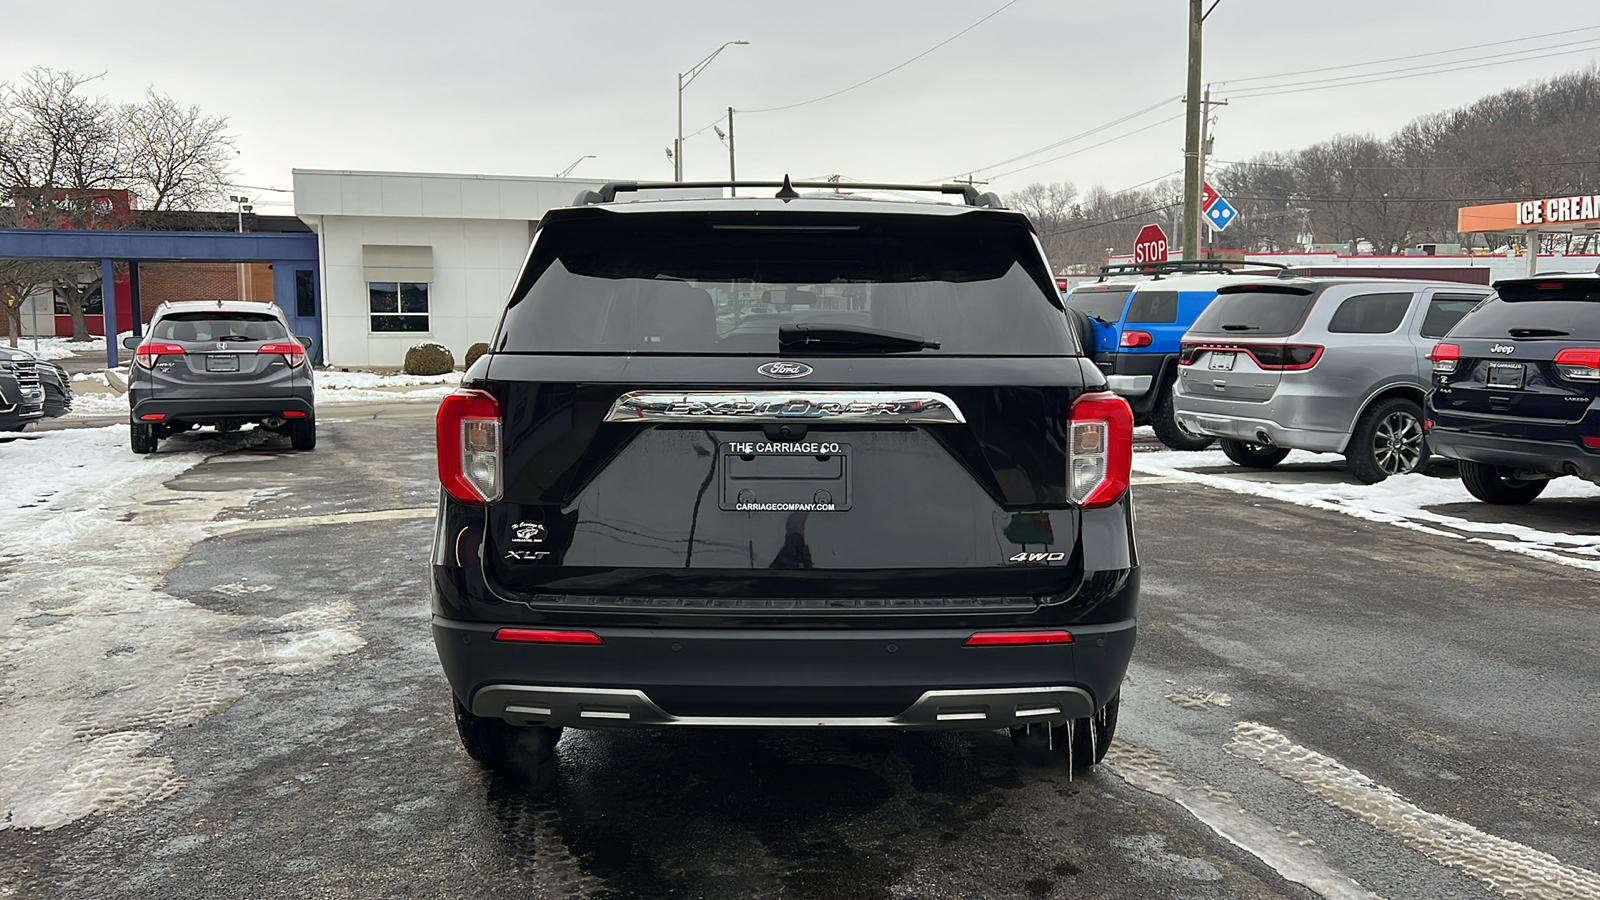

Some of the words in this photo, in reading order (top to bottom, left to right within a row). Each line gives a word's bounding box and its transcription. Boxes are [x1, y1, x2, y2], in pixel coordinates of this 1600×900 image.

[1516, 200, 1543, 225] ICE
[1136, 240, 1166, 263] STOP
[1490, 343, 1515, 355] Jeep
[770, 361, 800, 375] Ford
[663, 401, 905, 415] EXPLORER
[729, 442, 754, 454] THE
[756, 442, 819, 453] CARRIAGE
[821, 442, 842, 454] CO.
[736, 503, 835, 511] CARRIAGECOMPANY.COM
[504, 550, 551, 560] XLT
[1009, 552, 1065, 562] 4WD
